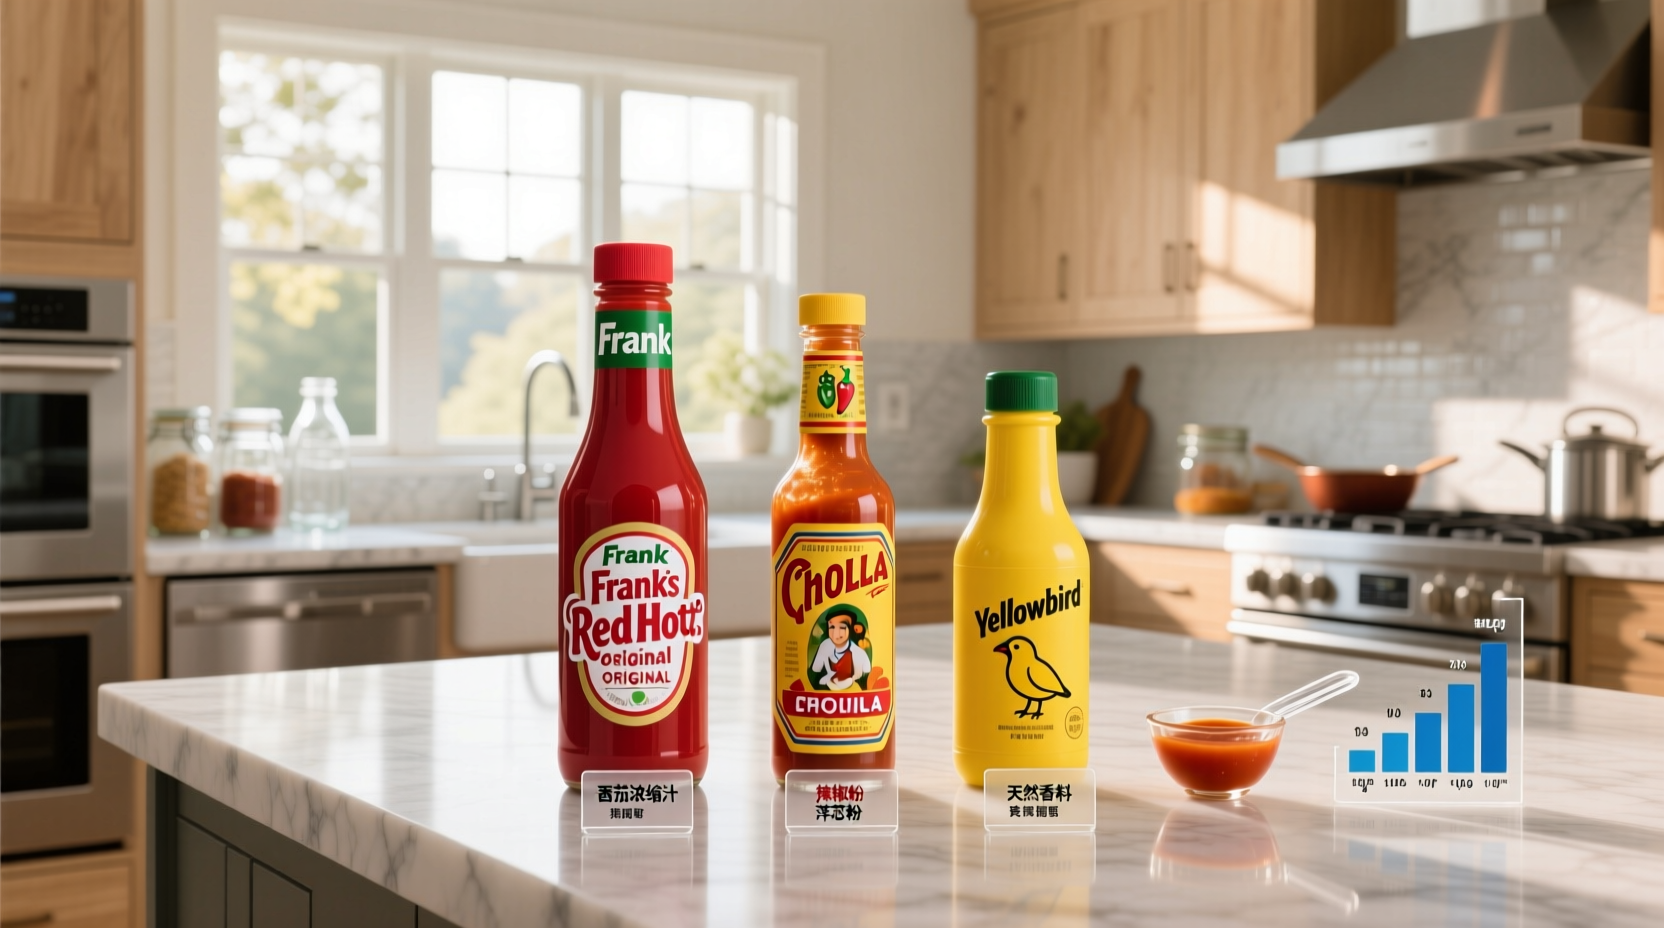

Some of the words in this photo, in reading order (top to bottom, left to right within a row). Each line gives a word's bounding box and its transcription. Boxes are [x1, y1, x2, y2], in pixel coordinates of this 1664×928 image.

[598, 322, 672, 355] Frank
[602, 544, 669, 566] Frank
[591, 569, 680, 605] Frank's
[974, 579, 1081, 638] Yellowbird
[602, 670, 671, 685] ORIGINAL
[1007, 783, 1072, 802] 天然香料
